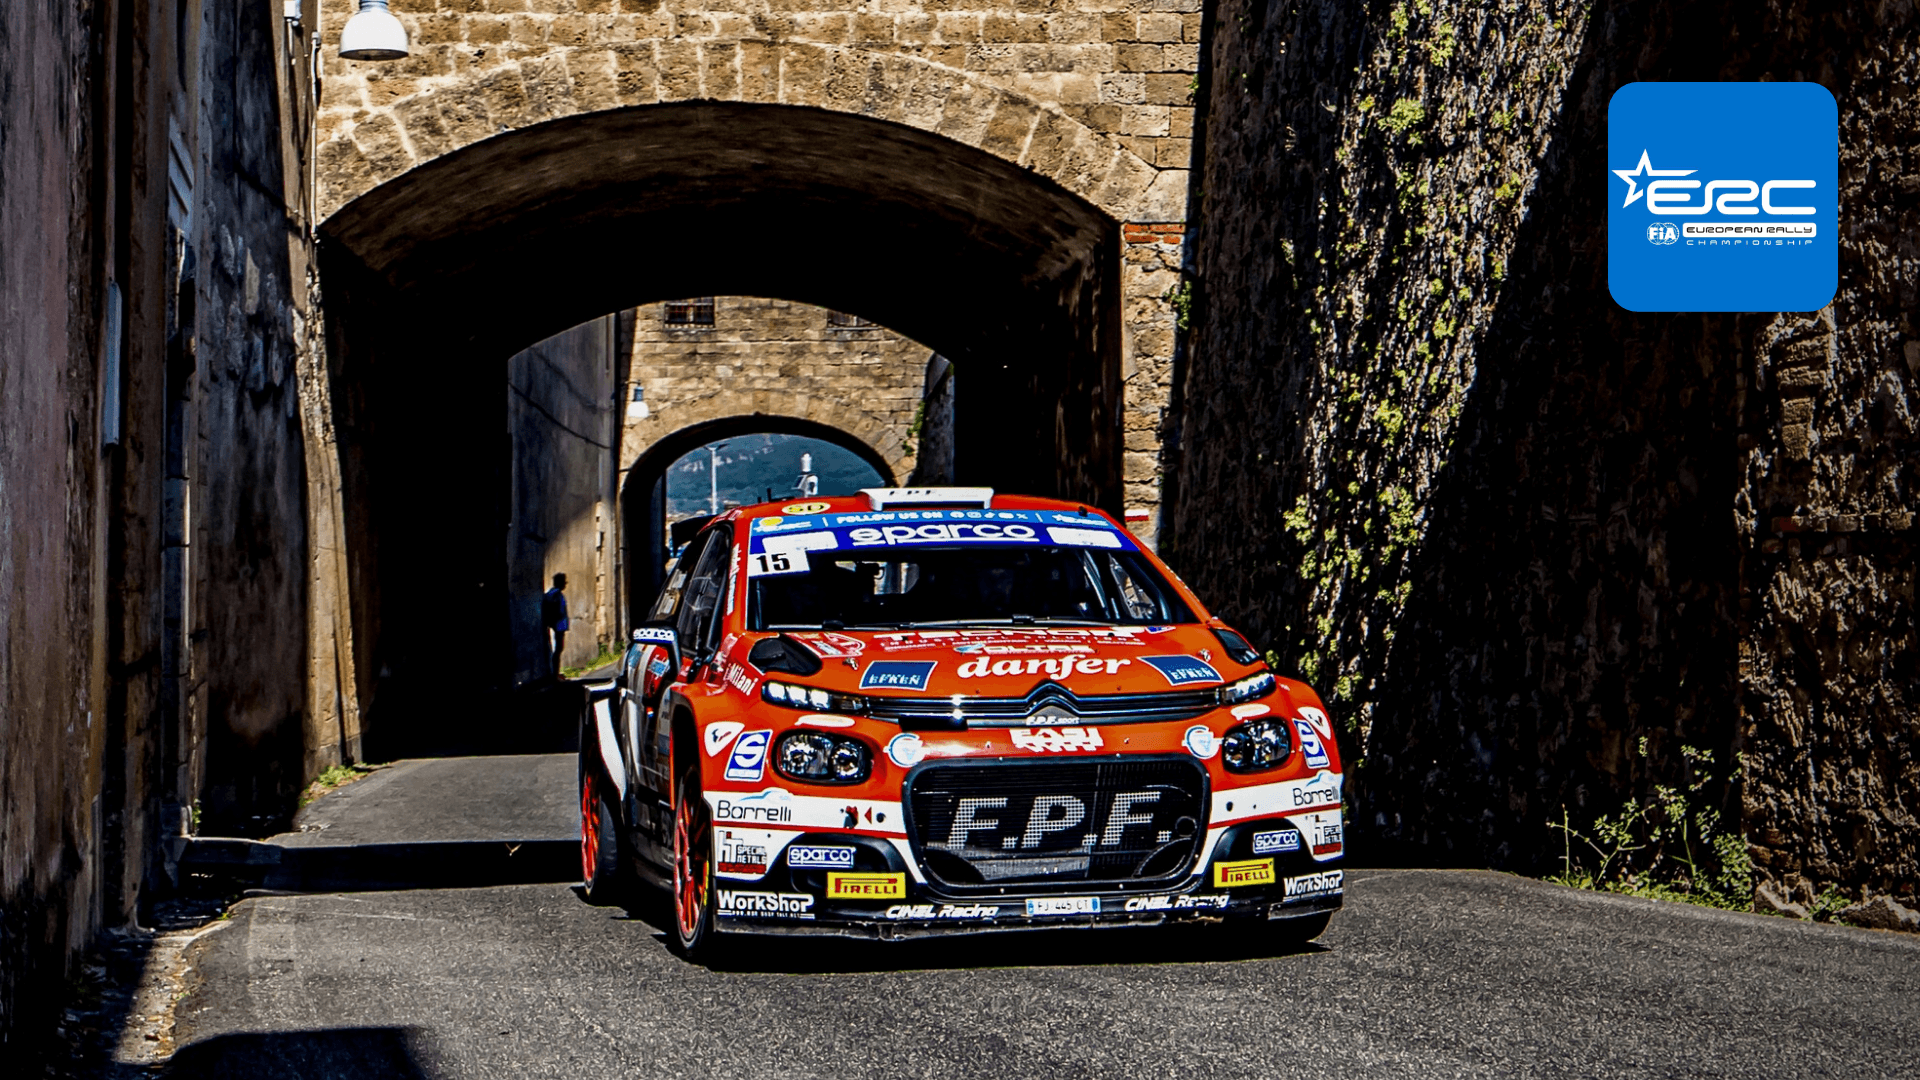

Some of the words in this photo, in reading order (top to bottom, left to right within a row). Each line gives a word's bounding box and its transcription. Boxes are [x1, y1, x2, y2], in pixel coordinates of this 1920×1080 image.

[837, 512, 895, 524] FOLLOW
[899, 511, 919, 520] US
[922, 511, 943, 519] ON
[849, 523, 1036, 546] sparco
[756, 552, 791, 573] 15
[956, 654, 1131, 681] danfer
[1292, 787, 1340, 807] Borrelli
[717, 800, 792, 822] Borrelli
[947, 791, 1173, 849] F.P.F.
[1255, 831, 1298, 849] sparco
[790, 847, 851, 864] sparco
[1221, 863, 1269, 883] PIRELLI
[834, 877, 898, 894] PIRELLI
[938, 903, 999, 921] Racing
